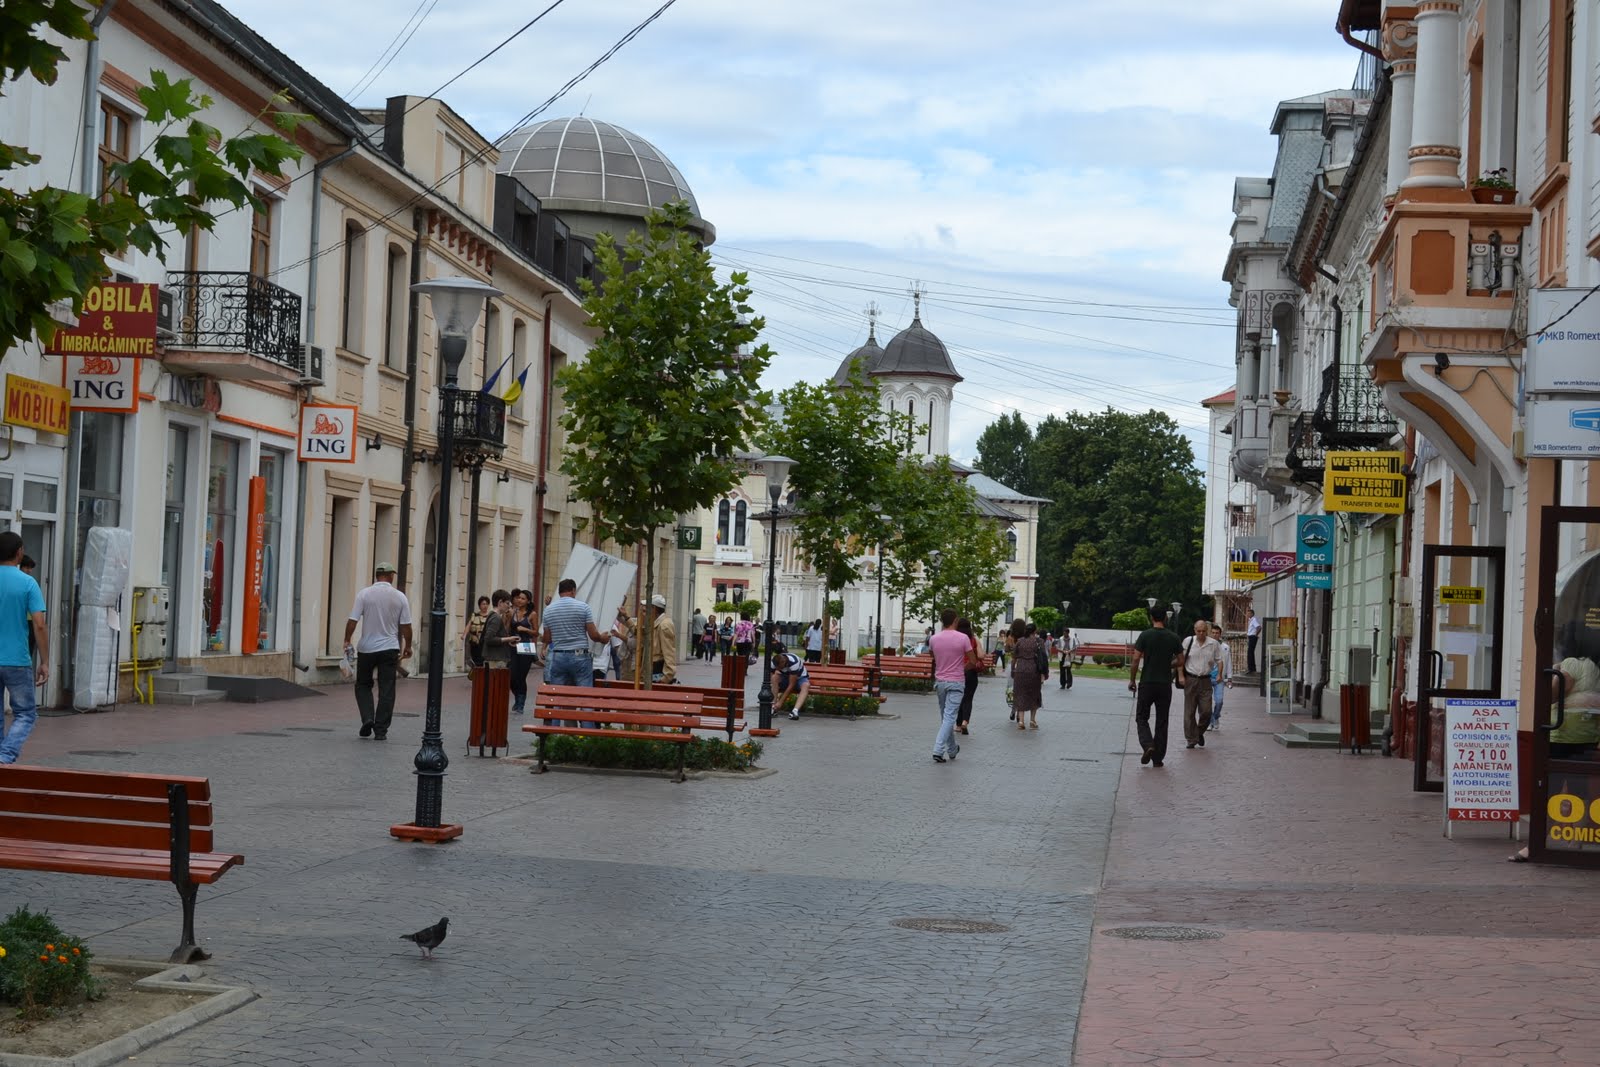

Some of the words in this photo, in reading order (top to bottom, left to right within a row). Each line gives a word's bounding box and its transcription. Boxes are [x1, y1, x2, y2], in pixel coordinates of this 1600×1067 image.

[82, 283, 153, 313] OBILĂ
[103, 316, 114, 330] &
[1545, 331, 1565, 341] MKB
[61, 332, 154, 355] ÎMBRĂCĂMINTE
[73, 380, 125, 400] ING
[8, 388, 67, 430] MOBILA
[306, 438, 346, 454] ING
[1332, 457, 1389, 467] WESTERN
[1335, 477, 1392, 488] WESTERN
[1351, 487, 1392, 497] UNION
[1261, 557, 1294, 566] Arcade
[1304, 553, 1326, 561] BCC
[1472, 709, 1500, 717] ASA
[1453, 723, 1510, 731] AMANET
[1453, 762, 1512, 771] AMANETAM
[1452, 779, 1512, 787] IMOBILIARE
[1457, 810, 1512, 820] XEROX
